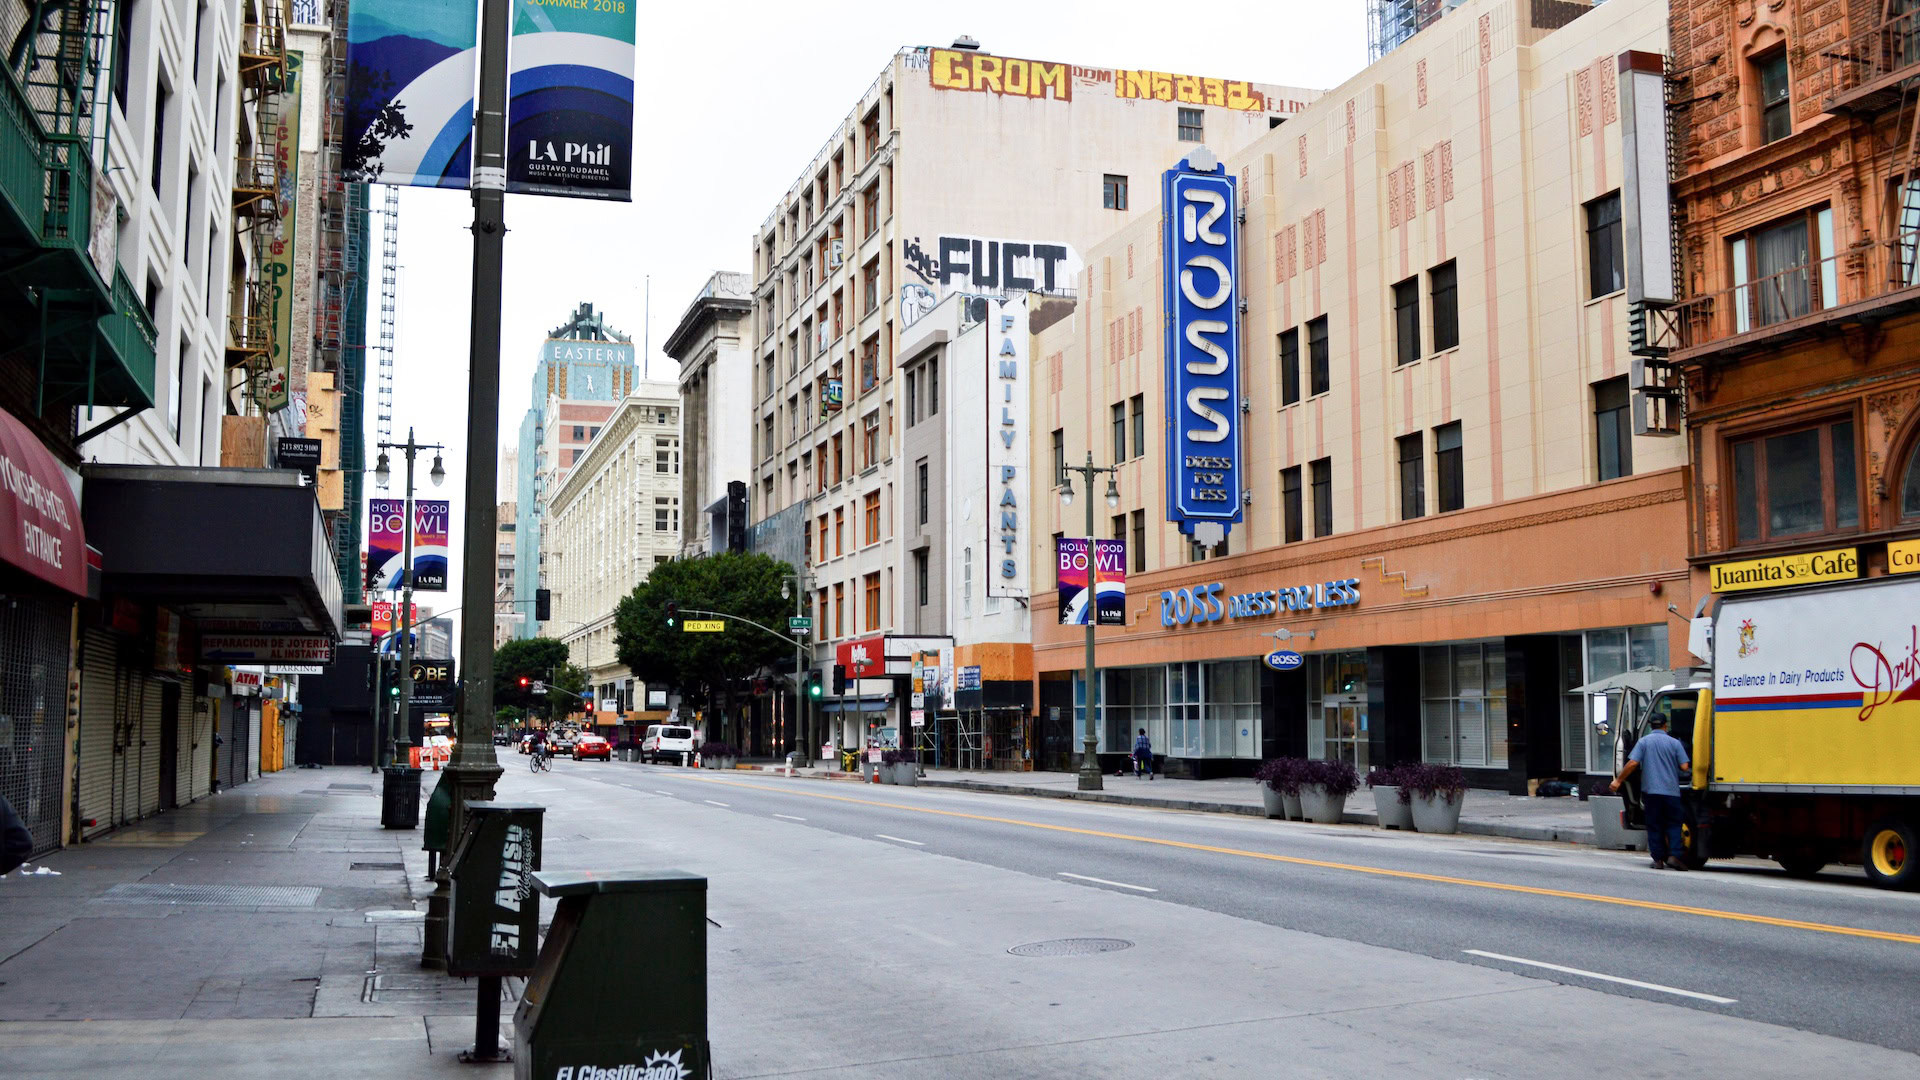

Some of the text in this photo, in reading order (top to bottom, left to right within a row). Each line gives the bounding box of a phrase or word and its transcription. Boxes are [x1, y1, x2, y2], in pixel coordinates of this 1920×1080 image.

[527, 0, 626, 14] SUMMER 2018
[932, 49, 1069, 100] GROM
[530, 140, 610, 166] LA Phil
[528, 163, 610, 176] GUSTAVO DUDAMEL
[554, 172, 580, 180] ARTISTIC
[939, 236, 1067, 291] FUCT
[1180, 188, 1232, 443] ROSS
[554, 346, 626, 362] EASTERN
[999, 315, 1018, 579] FAMILY PANTS
[1185, 455, 1233, 470] DRESS
[1194, 472, 1224, 486] FOR
[1190, 487, 1228, 502] LESS
[24, 519, 62, 570] ENTRANCE
[1714, 553, 1857, 589] Juanita's Cafe
[1160, 578, 1361, 627] ROSS DRESS FOR LESS
[270, 640, 284, 649] DE
[270, 650, 330, 659] AL INSTANTE
[1271, 654, 1300, 665] ROSS
[236, 672, 259, 686] ATM
[1723, 667, 1844, 688] Excellence In Dairy Products
[578, 1063, 678, 1080] Clasificado
